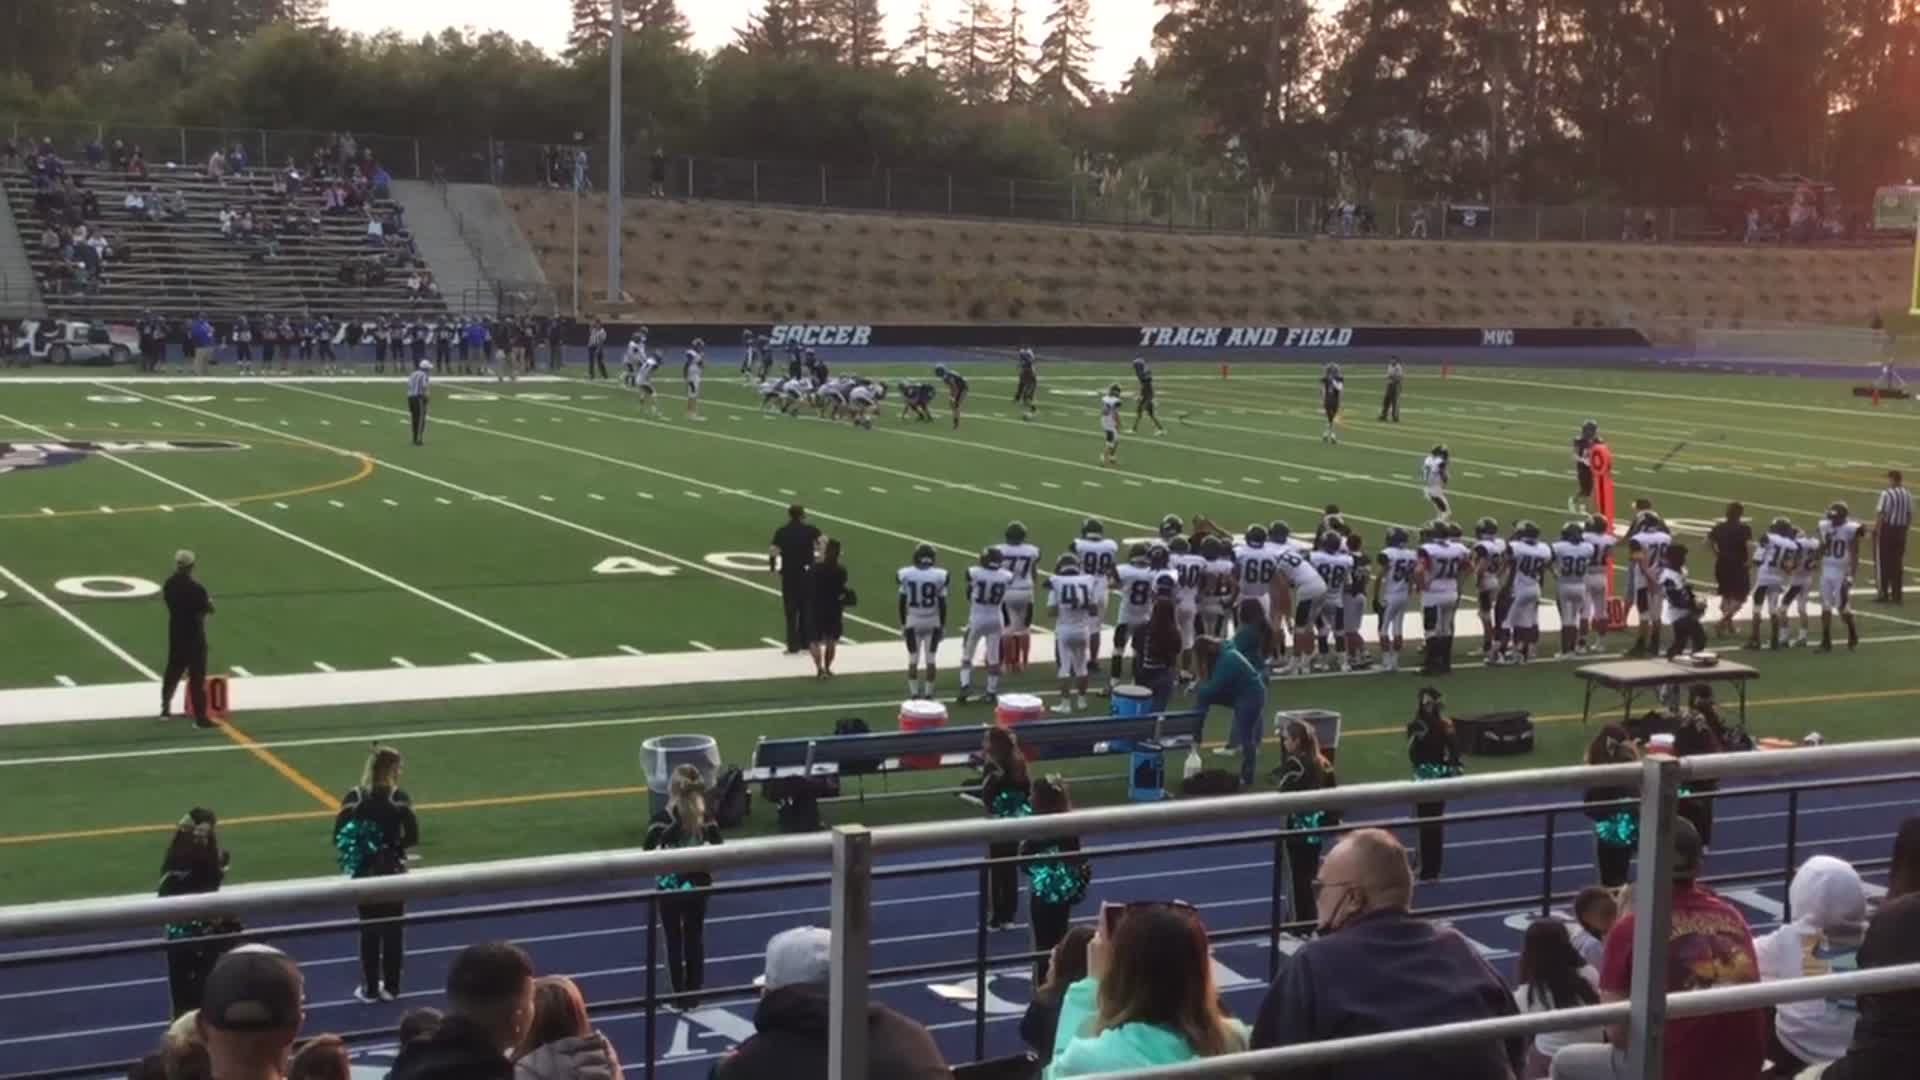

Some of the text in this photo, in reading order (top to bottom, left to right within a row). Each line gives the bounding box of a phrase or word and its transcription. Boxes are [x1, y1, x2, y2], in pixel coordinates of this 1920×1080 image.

[769, 326, 872, 345] SOCCER
[1140, 328, 1353, 346] TRACK AND FIELD
